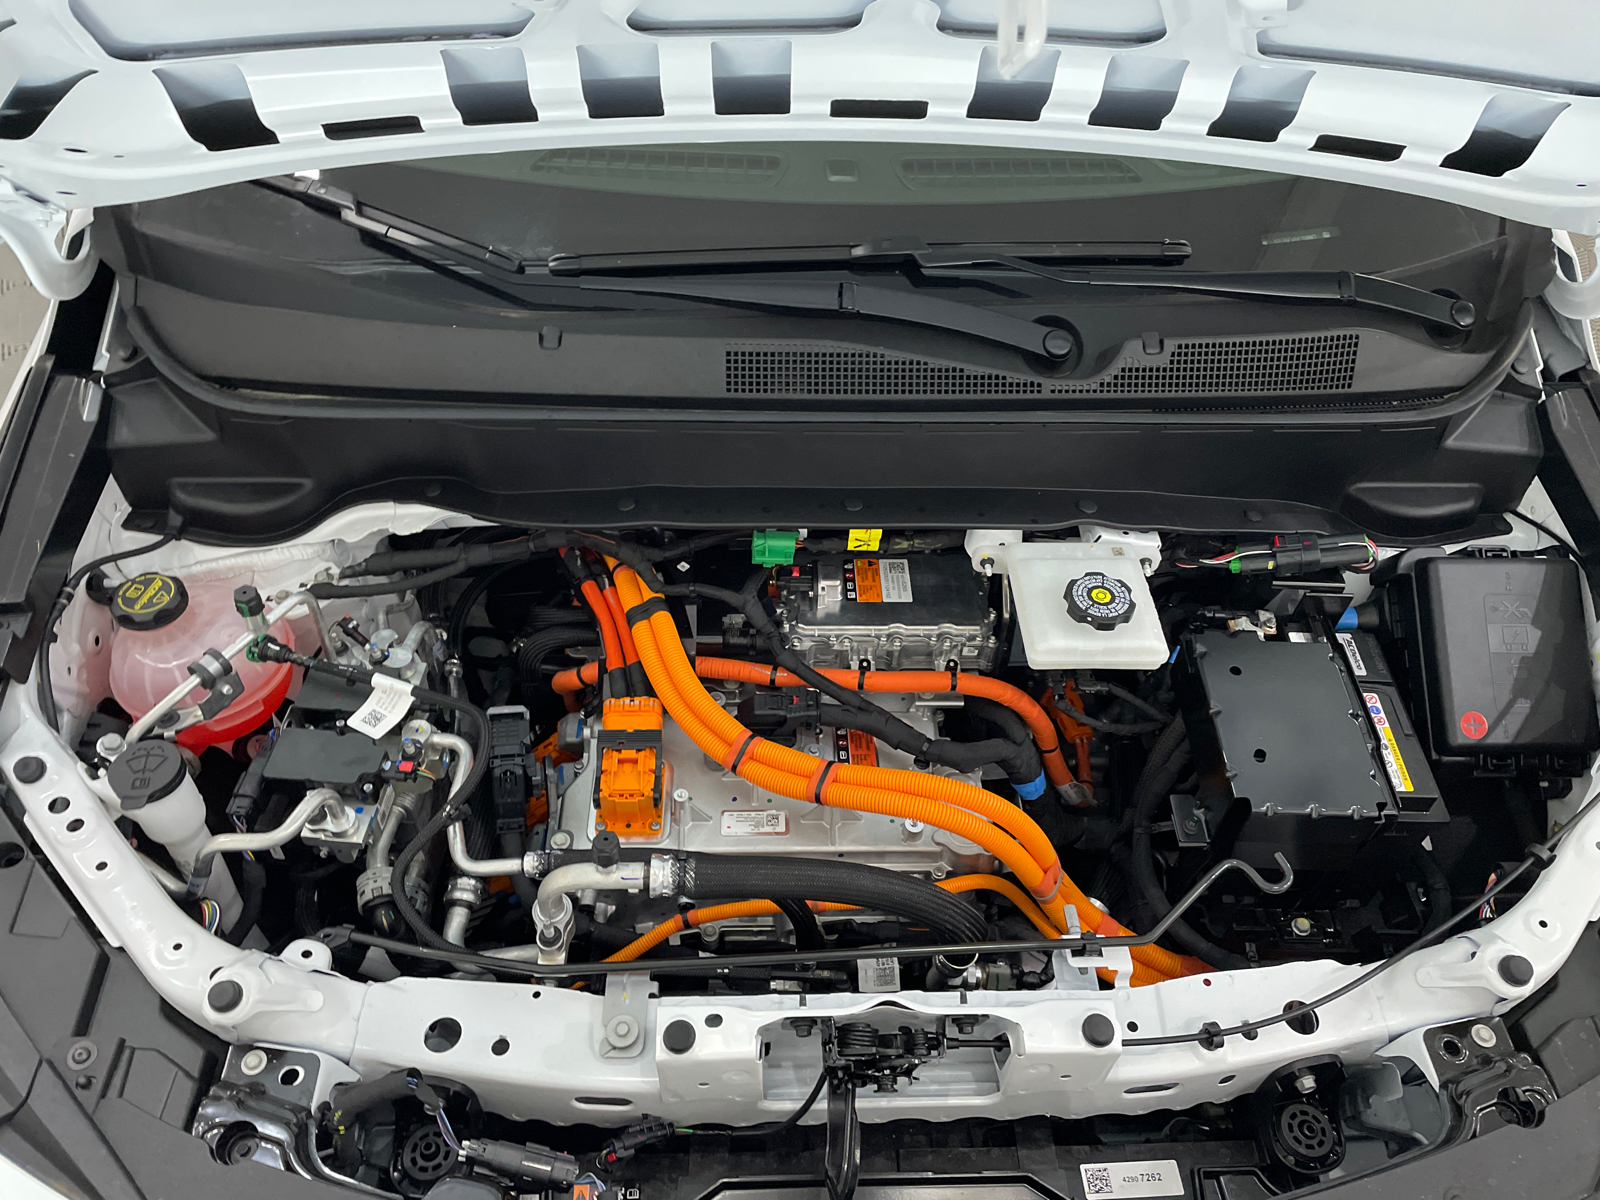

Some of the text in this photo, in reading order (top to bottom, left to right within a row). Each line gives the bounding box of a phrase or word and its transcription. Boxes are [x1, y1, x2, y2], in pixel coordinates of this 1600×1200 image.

[1346, 638, 1362, 670] ACDelco
[1390, 742, 1400, 761] DANGER
[1398, 763, 1408, 781] POISON
